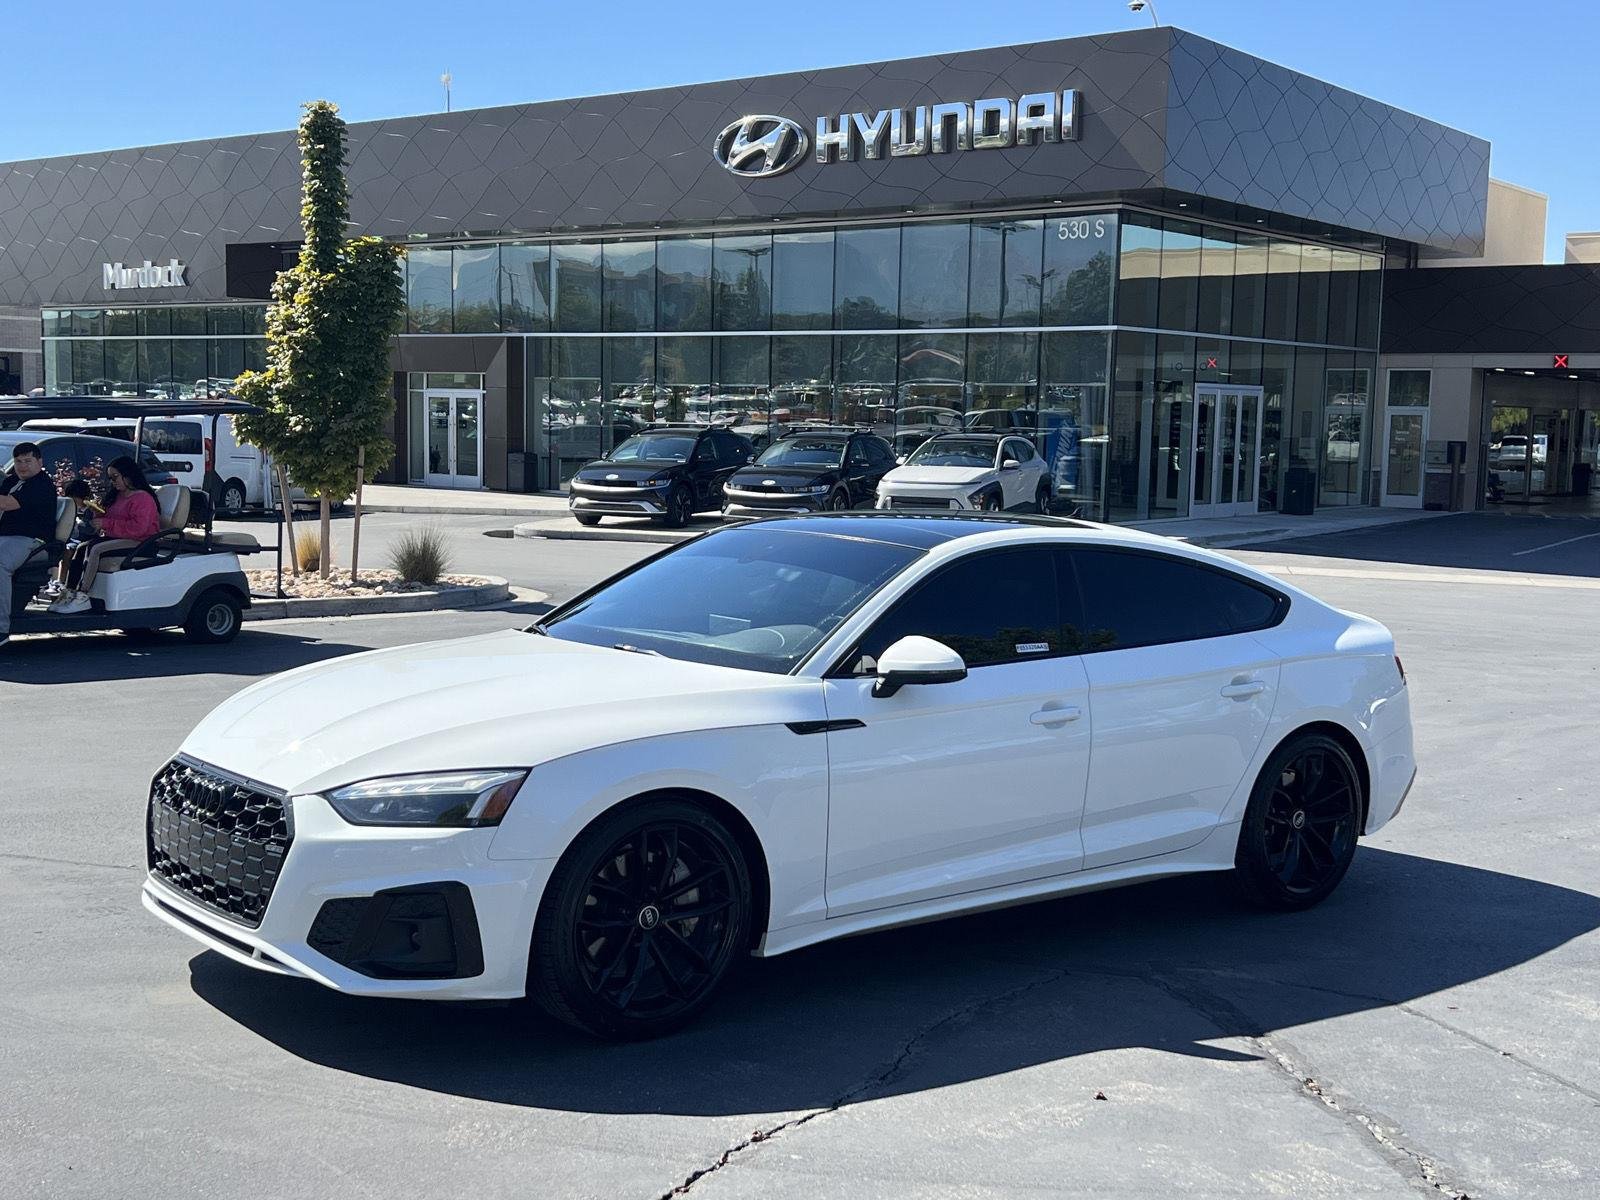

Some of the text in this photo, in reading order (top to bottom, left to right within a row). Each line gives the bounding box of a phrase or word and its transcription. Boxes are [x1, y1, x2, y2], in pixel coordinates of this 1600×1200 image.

[815, 89, 1080, 163] HYUNDAI
[1058, 218, 1105, 240] 530 S
[102, 258, 187, 290] Murdock
